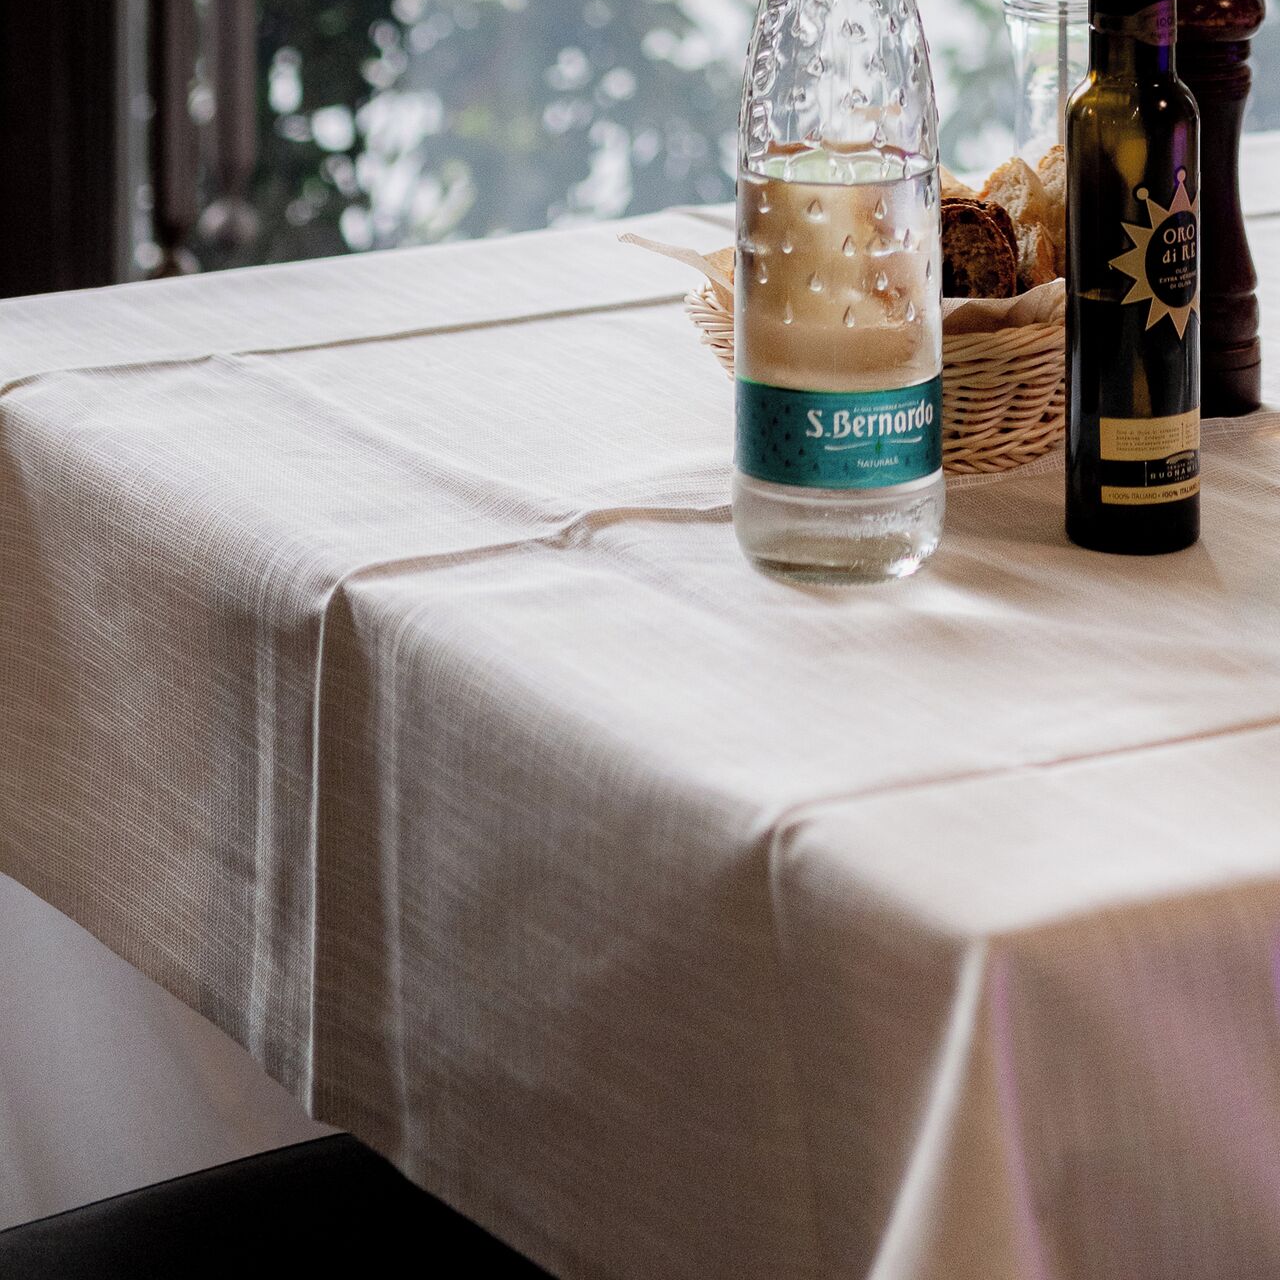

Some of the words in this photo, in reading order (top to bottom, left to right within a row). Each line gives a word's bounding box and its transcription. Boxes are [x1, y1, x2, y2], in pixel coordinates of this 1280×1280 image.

[1163, 223, 1195, 244] ORO
[1162, 248, 1176, 264] di
[1182, 241, 1196, 261] RE
[805, 398, 934, 439] S.Bernardo
[857, 456, 899, 469] NATURALE
